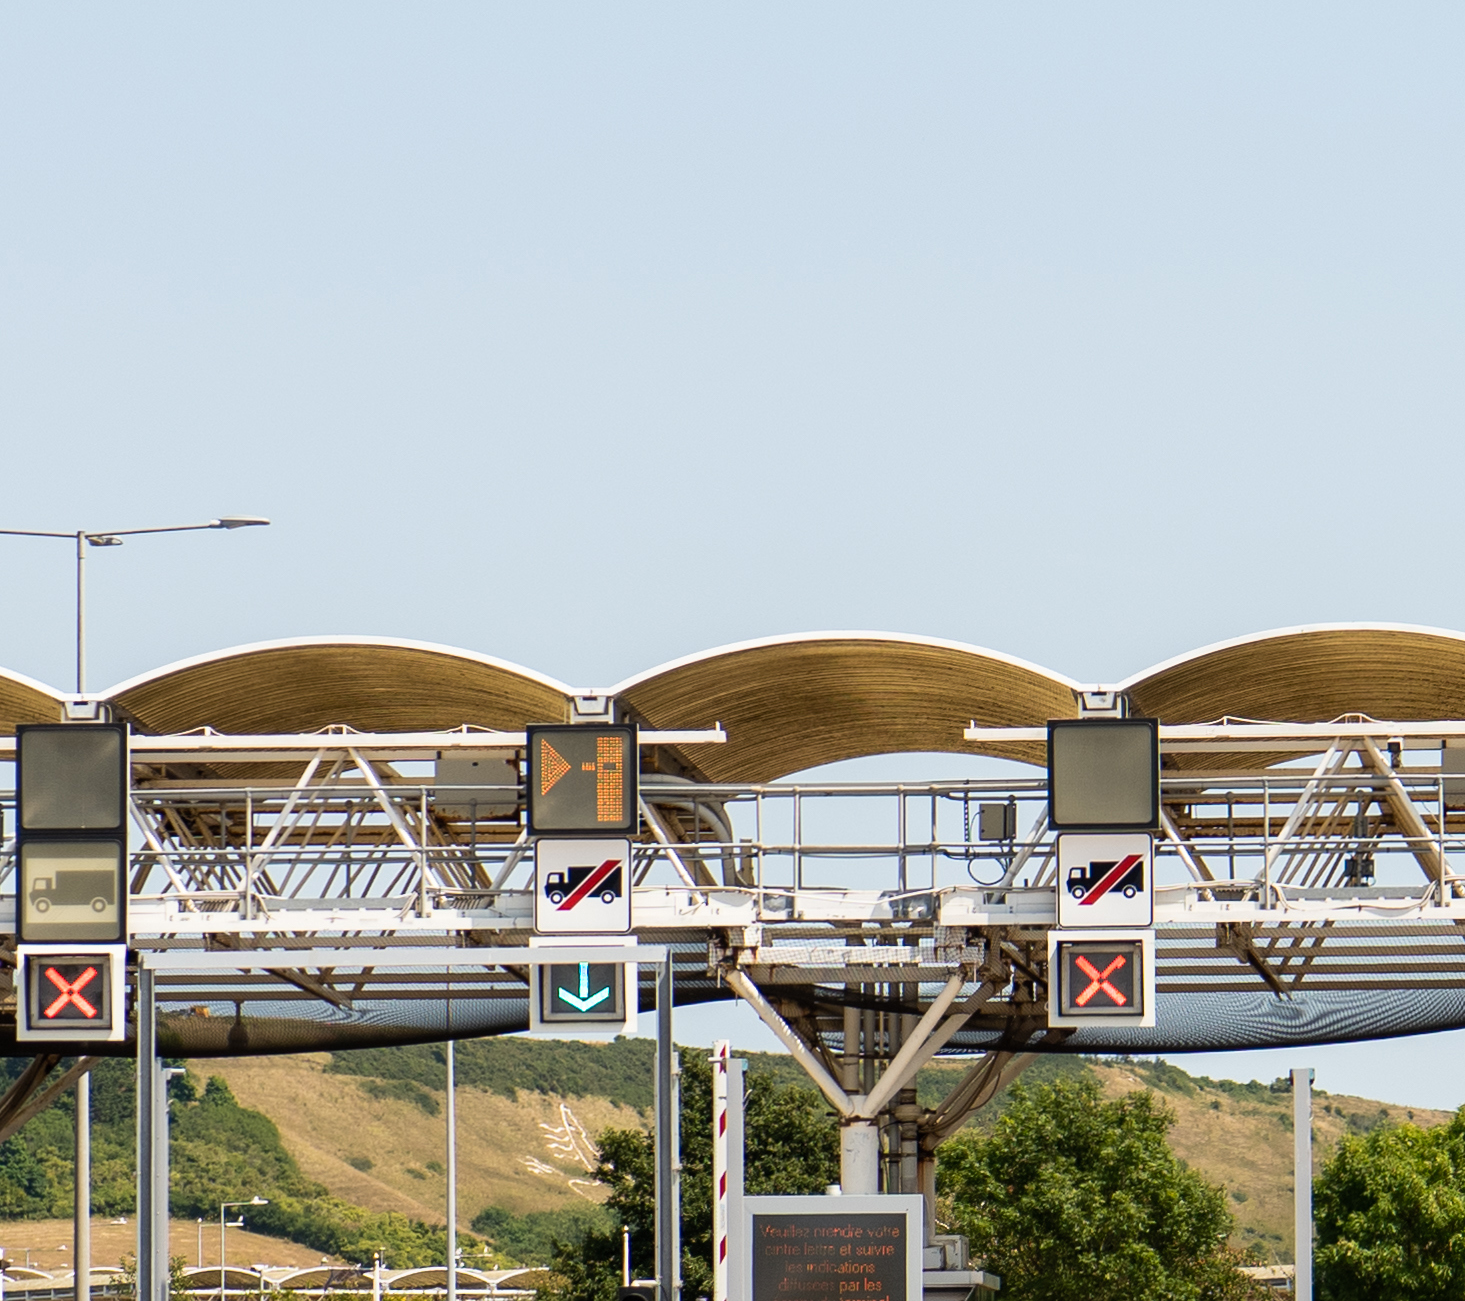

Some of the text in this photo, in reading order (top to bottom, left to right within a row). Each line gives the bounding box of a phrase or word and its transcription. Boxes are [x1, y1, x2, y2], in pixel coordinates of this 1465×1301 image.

[839, 1243, 852, 1256] et
[855, 1241, 895, 1256] suivre
[839, 1280, 860, 1294] par
[864, 1277, 883, 1292] les
